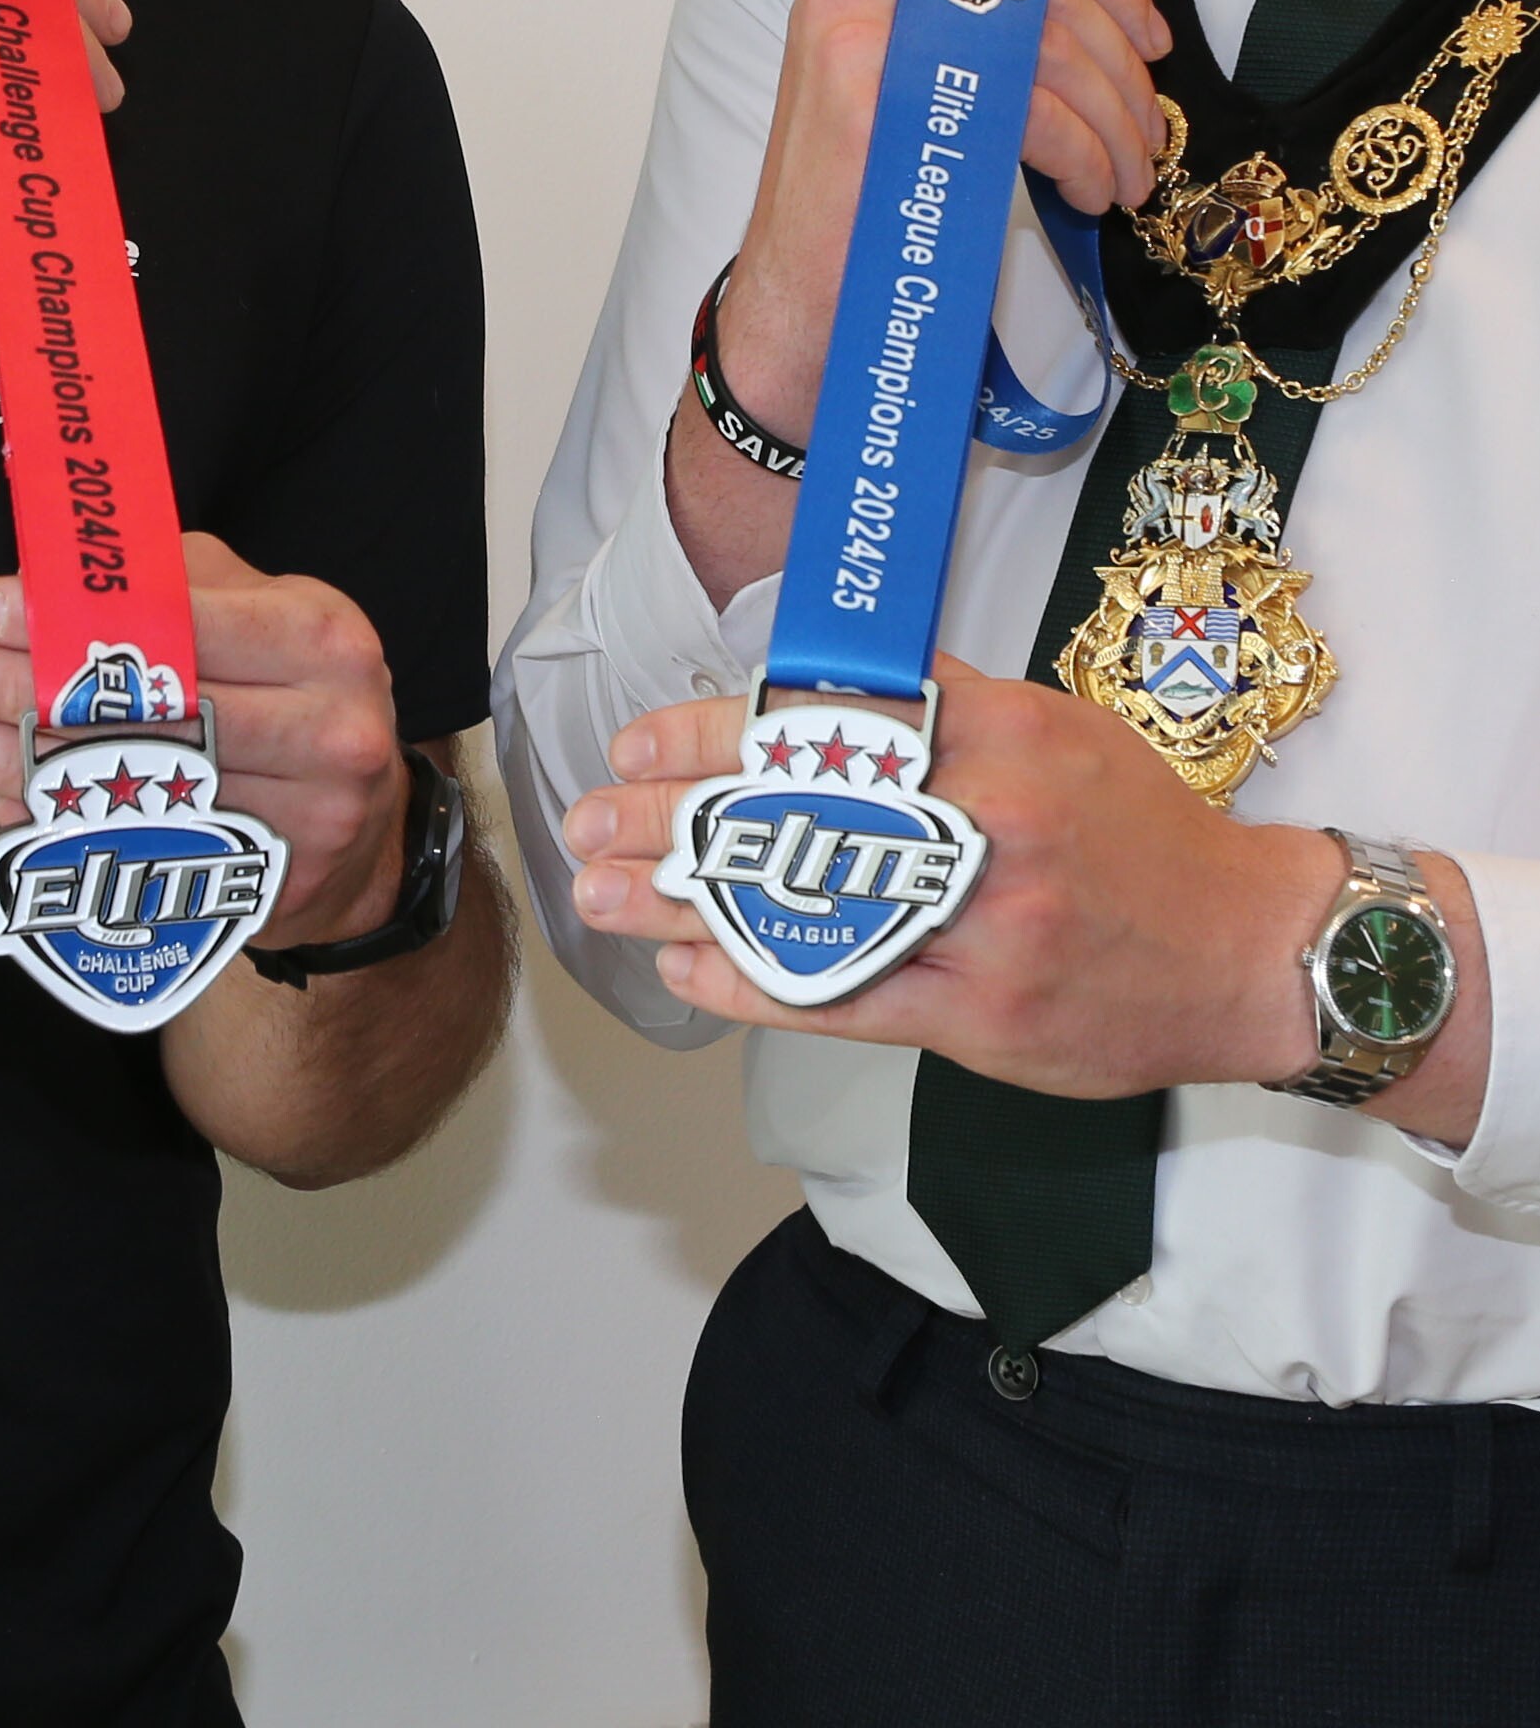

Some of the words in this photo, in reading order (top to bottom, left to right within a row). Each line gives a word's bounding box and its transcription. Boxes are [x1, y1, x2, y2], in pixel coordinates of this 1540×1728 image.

[927, 63, 980, 137] Elite
[13, 173, 61, 239] Cup
[899, 142, 965, 265] League
[31, 251, 94, 444] Champions
[860, 274, 939, 469] Champions
[979, 386, 1057, 440] 24/25
[65, 457, 129, 593] 2024/25
[832, 476, 900, 613] 2024/25
[88, 658, 135, 725] ELI
[2, 849, 270, 949] ELITE
[691, 811, 963, 917] ELITE
[77, 944, 191, 974] CHALLENGE
[758, 917, 856, 945] LEAGUE
[114, 975, 156, 994] CUP
